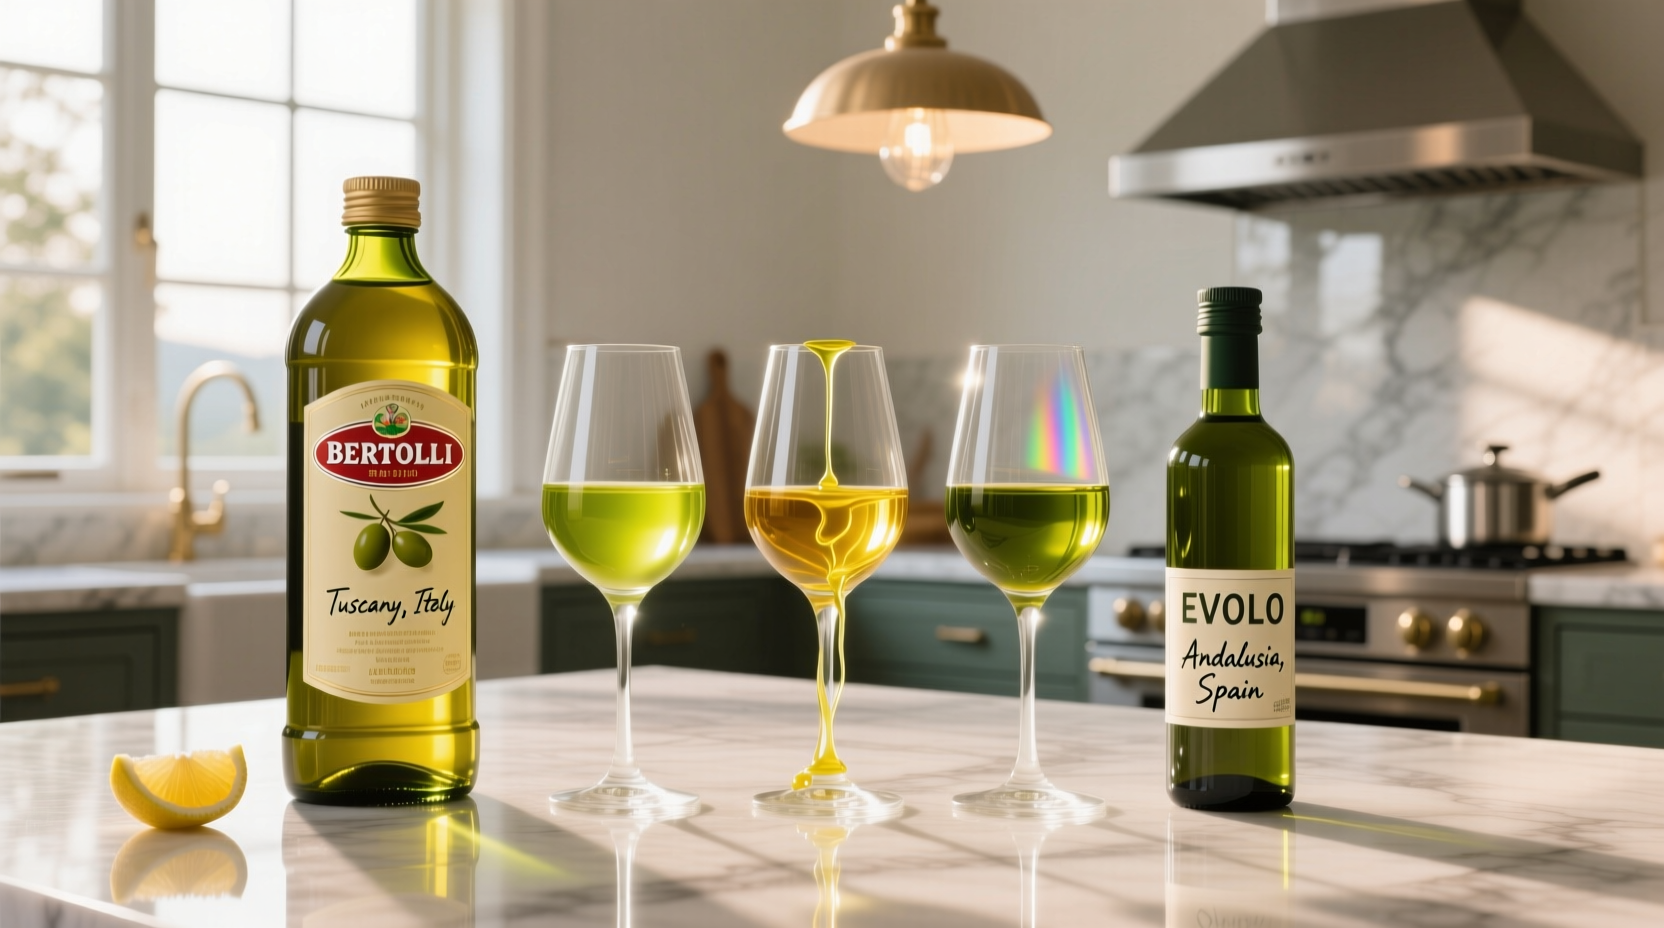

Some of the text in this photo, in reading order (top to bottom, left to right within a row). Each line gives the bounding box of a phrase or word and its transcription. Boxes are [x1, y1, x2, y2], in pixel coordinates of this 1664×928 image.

[326, 441, 453, 465] BERTOLLI
[326, 587, 455, 626] Tuscany, Italy
[1182, 592, 1284, 625] EVOLO
[1181, 638, 1284, 673] Andalusia,
[1196, 672, 1264, 713] Spain
